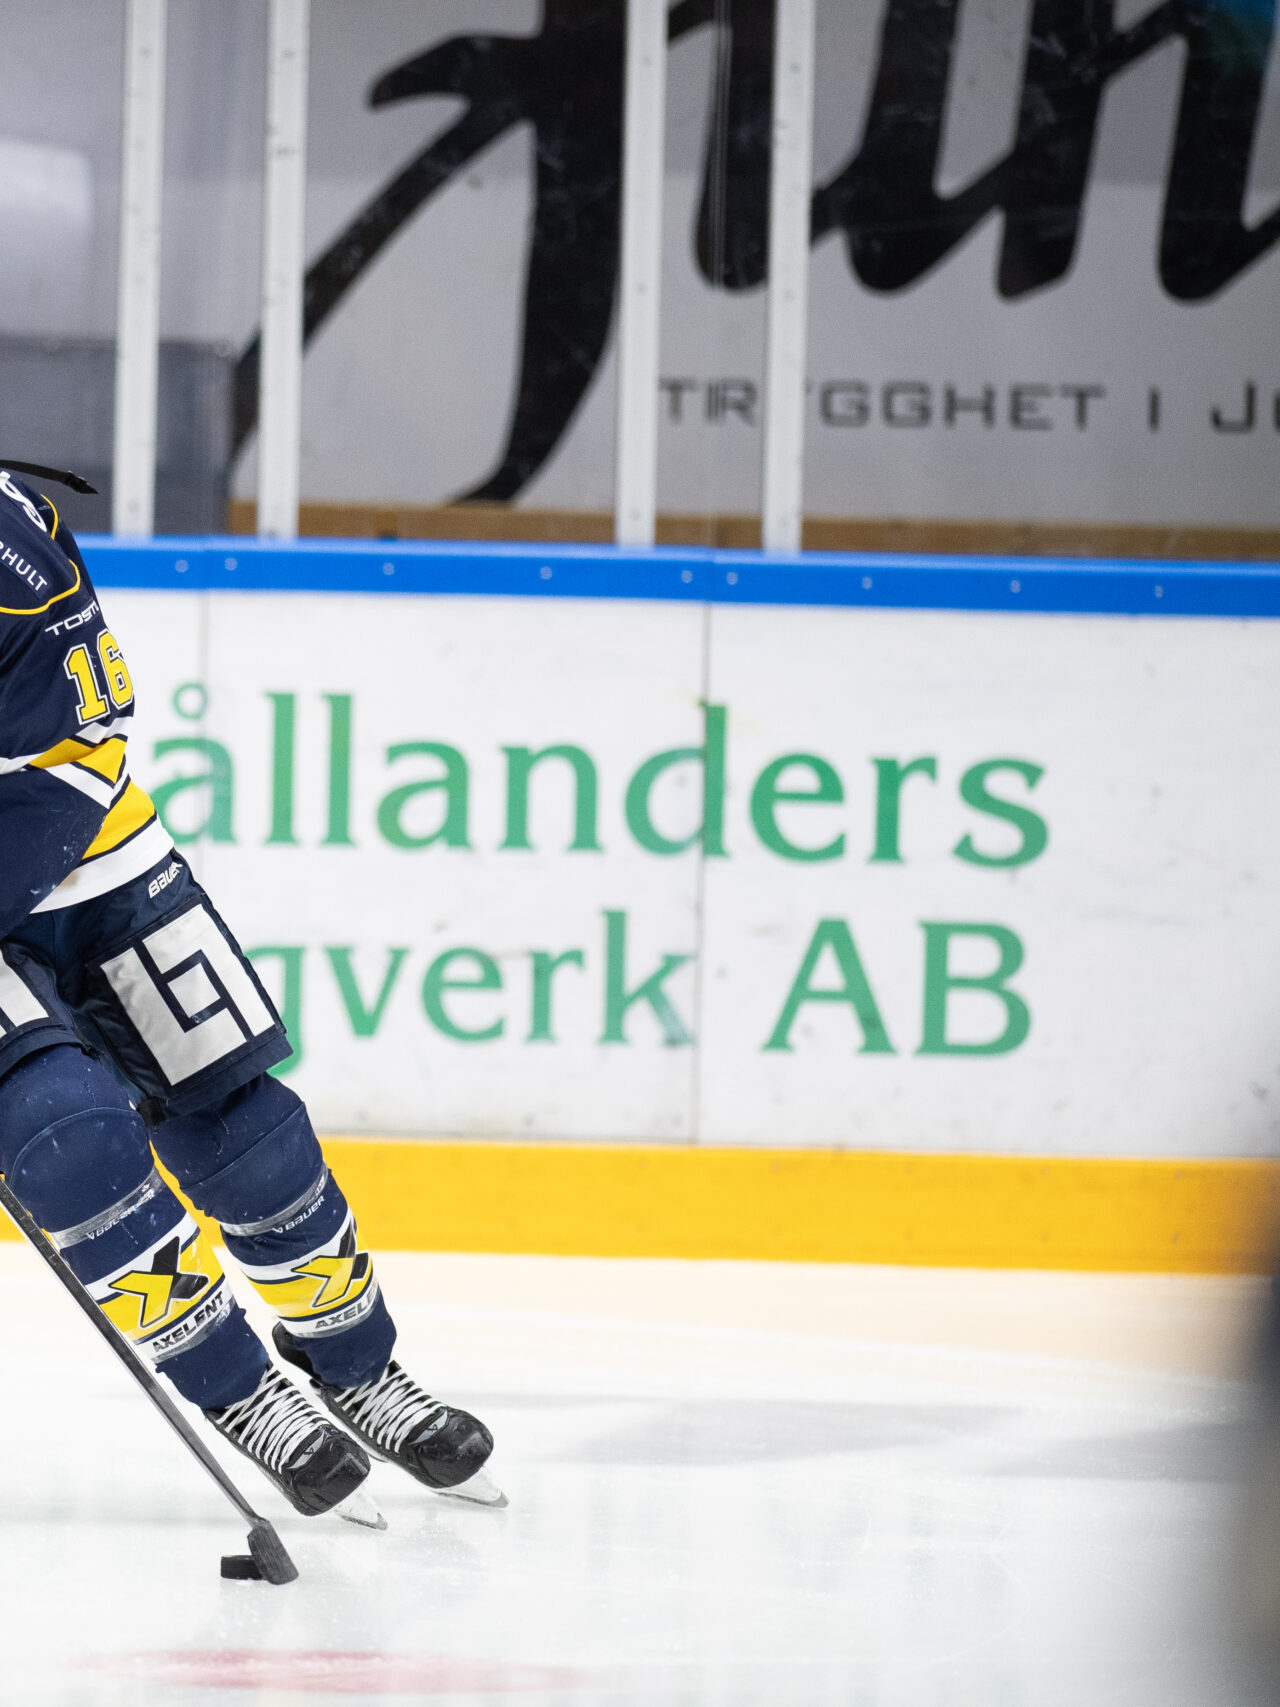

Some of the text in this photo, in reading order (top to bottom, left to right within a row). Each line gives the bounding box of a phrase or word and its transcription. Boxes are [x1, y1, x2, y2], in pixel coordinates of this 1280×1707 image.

[656, 376, 1107, 432] TRGGHET
[63, 628, 134, 725] 16
[149, 682, 1050, 870] ållanders
[760, 917, 1033, 1060] AB
[152, 1290, 223, 1353] AXELENT
[315, 1293, 376, 1330] AXEL
